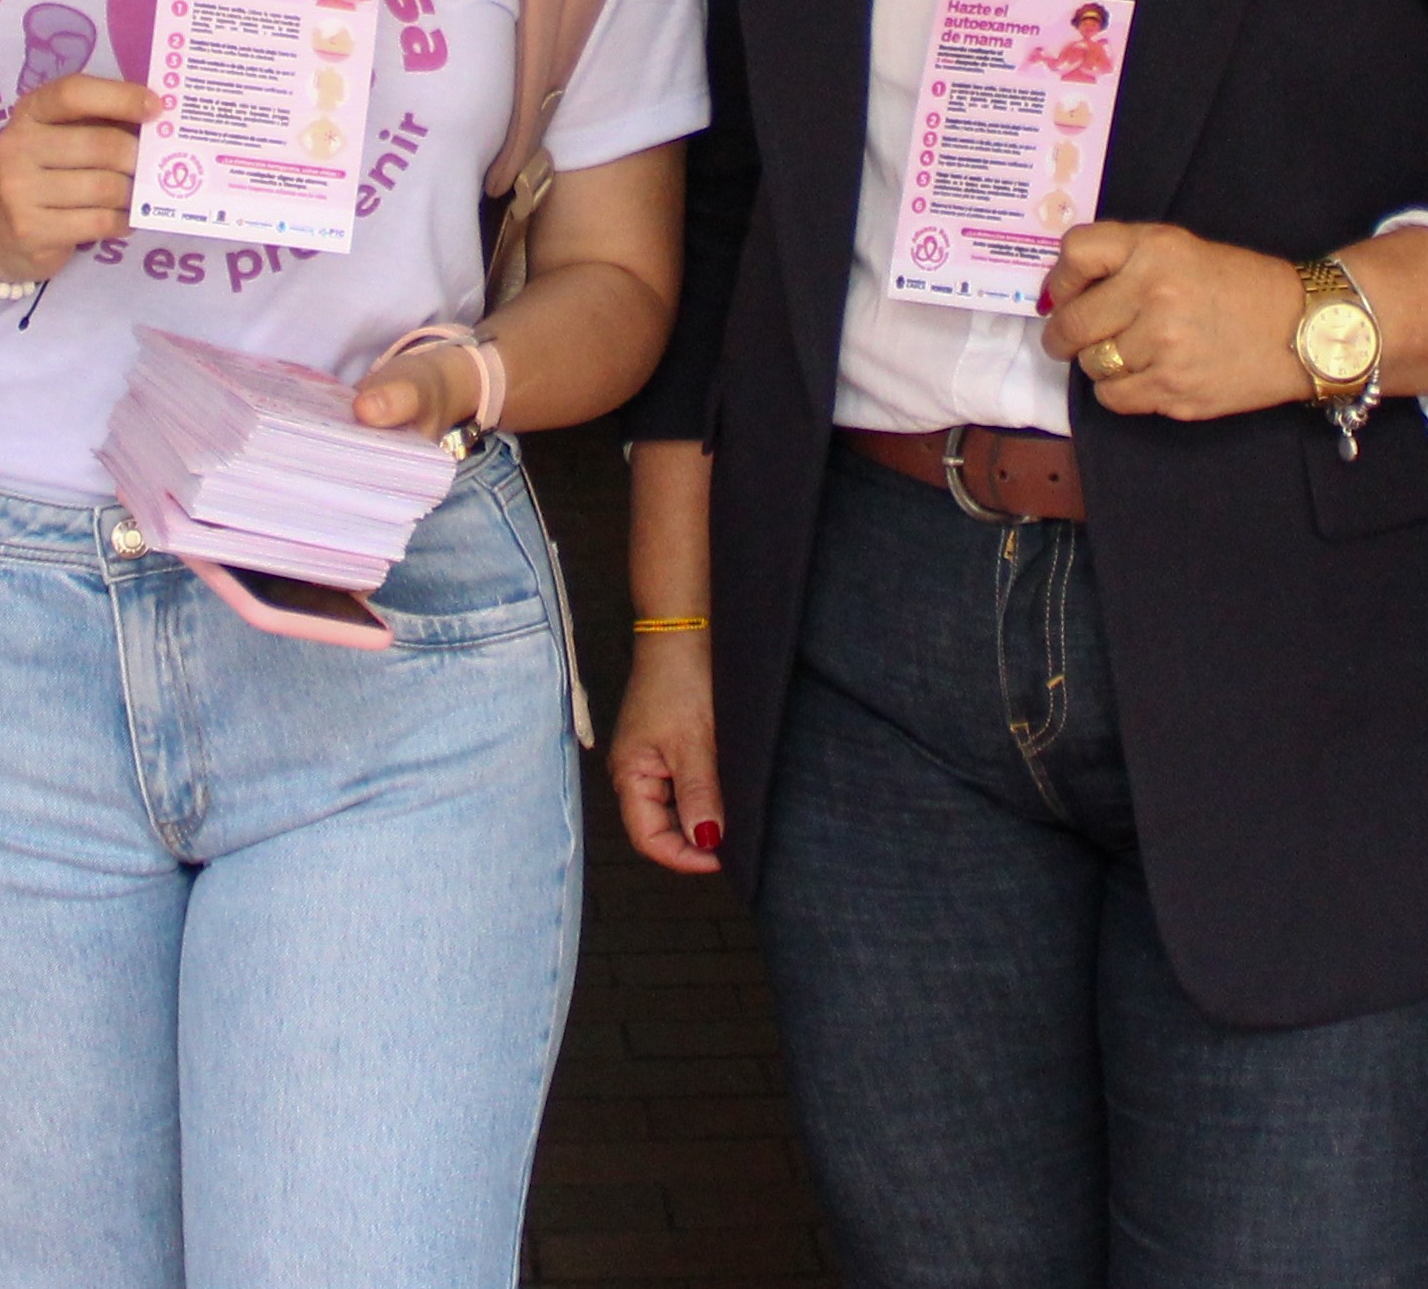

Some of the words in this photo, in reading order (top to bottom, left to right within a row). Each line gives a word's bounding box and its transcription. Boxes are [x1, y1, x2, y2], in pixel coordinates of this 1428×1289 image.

[947, 0, 991, 16] Hazte
[994, 4, 1009, 17] el
[944, 17, 1041, 36] autoexamen
[941, 29, 960, 43] de
[963, 33, 1013, 48] mama
[143, 247, 206, 286] es
